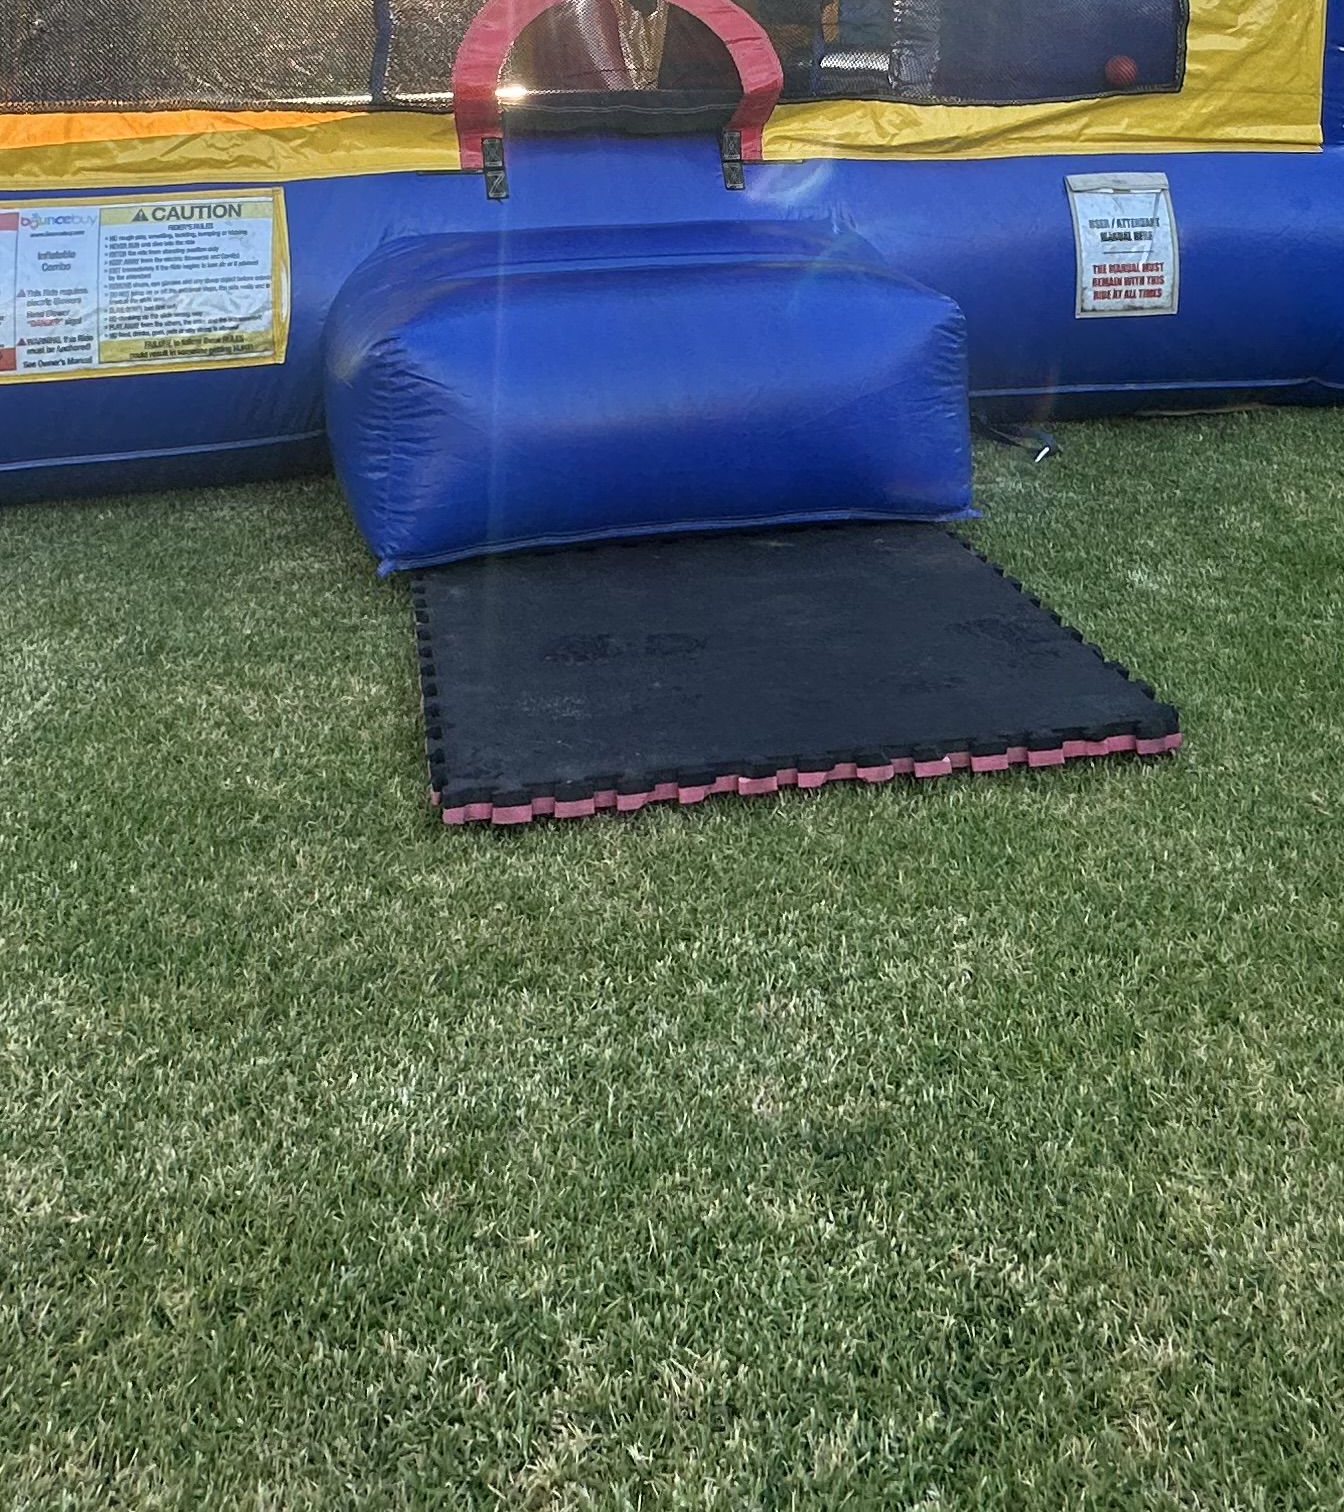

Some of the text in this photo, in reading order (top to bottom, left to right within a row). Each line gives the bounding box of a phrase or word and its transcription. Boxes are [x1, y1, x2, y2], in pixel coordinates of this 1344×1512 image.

[152, 203, 241, 221] CAUTION
[21, 213, 97, 229] bouncebuy
[38, 250, 76, 260] Inflatable
[42, 263, 71, 272] Combo
[1093, 262, 1164, 274] THE MANUAL MUST
[1093, 275, 1165, 287] REMAIN WITH THIS
[1093, 287, 1162, 300] RIDE AT ALL TIMES
